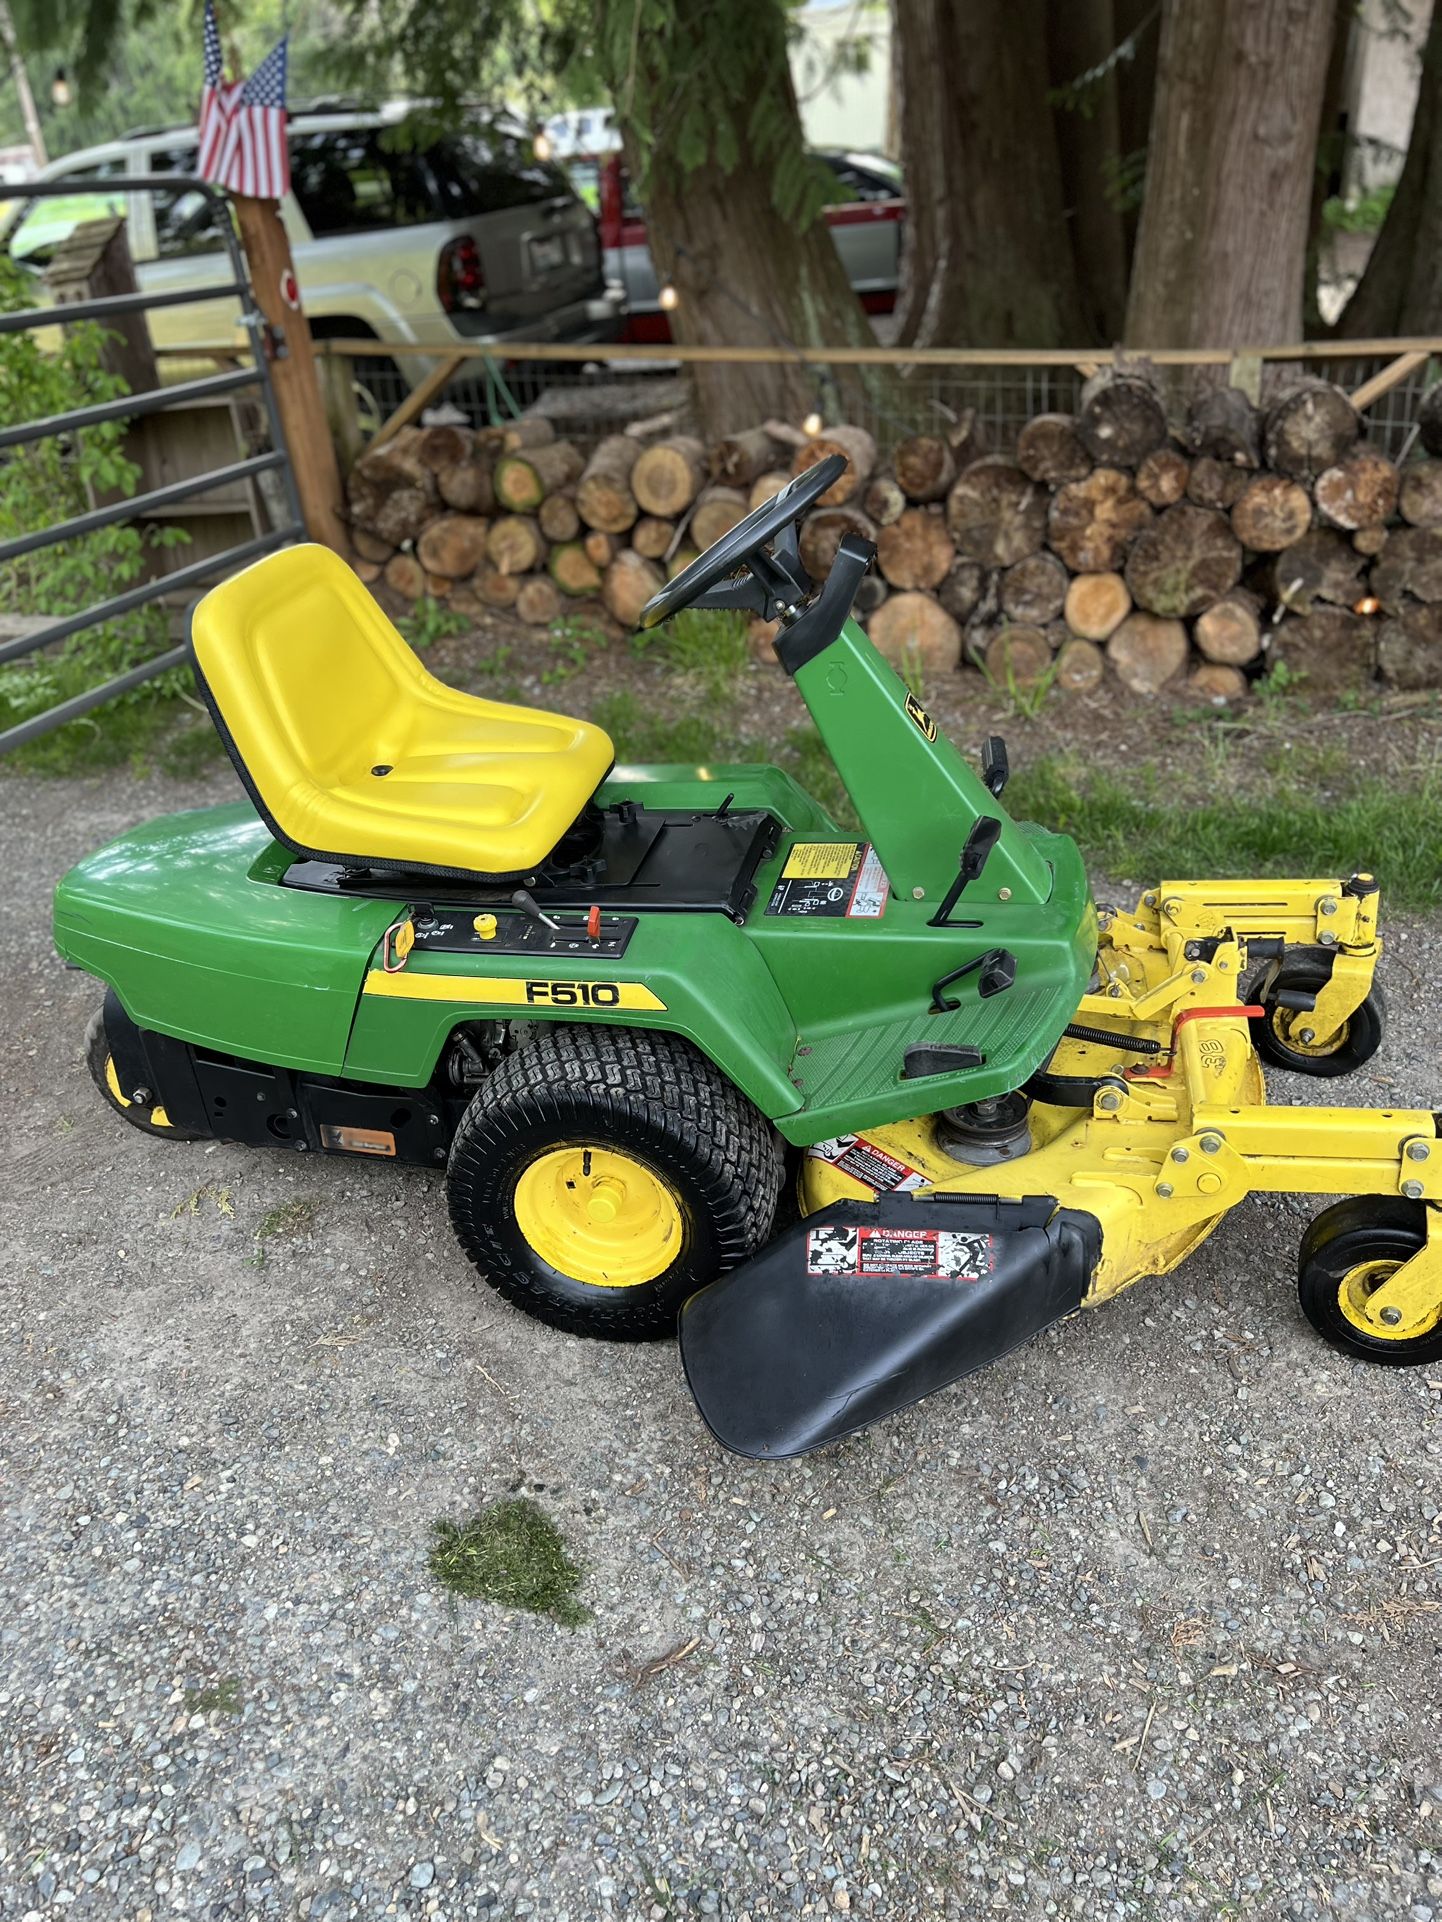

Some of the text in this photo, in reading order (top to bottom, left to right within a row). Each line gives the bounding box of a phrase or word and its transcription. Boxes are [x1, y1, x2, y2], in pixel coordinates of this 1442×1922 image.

[525, 981, 620, 1006] F510
[1199, 1039, 1226, 1069] 38
[872, 1149, 906, 1172] DANGER
[882, 1230, 928, 1239] DANGER
